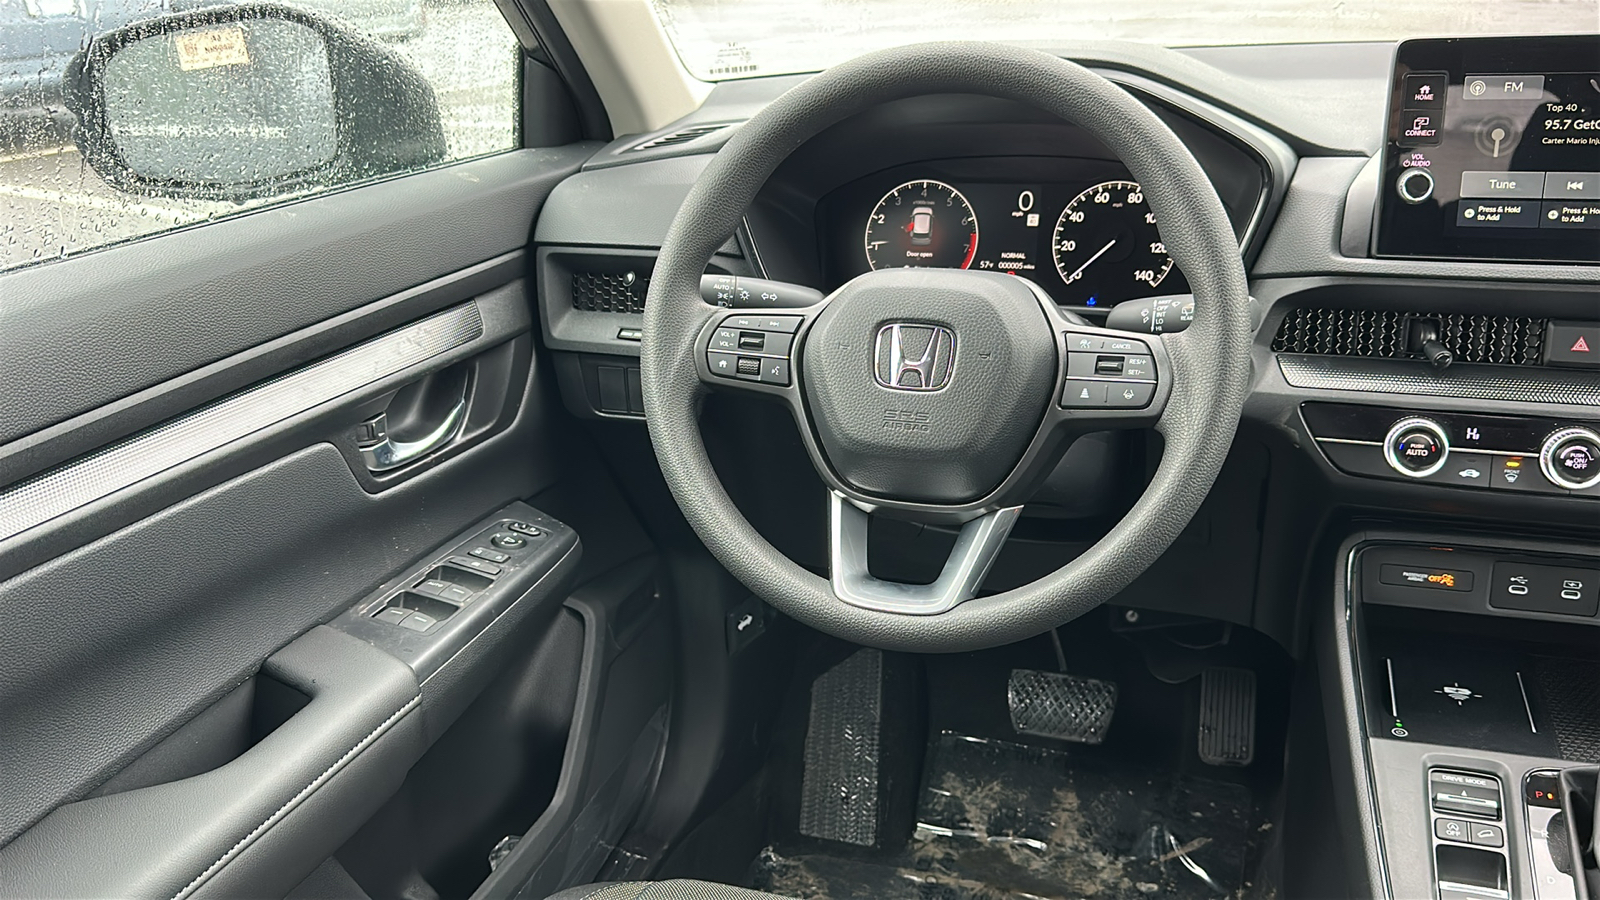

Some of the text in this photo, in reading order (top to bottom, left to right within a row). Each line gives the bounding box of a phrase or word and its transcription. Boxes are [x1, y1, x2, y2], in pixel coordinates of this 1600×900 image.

[1504, 81, 1524, 92] FM
[1546, 103, 1578, 113] Top 40
[1544, 119, 1572, 130] 95.7
[1489, 179, 1516, 190] Tune
[921, 189, 928, 198] 4
[1094, 192, 1110, 204] 60
[1127, 192, 1144, 204] 80
[895, 197, 902, 206] 3
[946, 198, 952, 206] 5
[1018, 190, 1034, 211] 0
[877, 214, 885, 224] 2
[962, 216, 968, 226] 6
[1069, 211, 1085, 222] 40
[963, 244, 969, 252] 7
[1060, 240, 1076, 251] 20
[1134, 270, 1154, 280] 140
[1428, 574, 1442, 582] OFF
[1442, 774, 1486, 786] DRIVE MODE
[1536, 790, 1544, 798] P
[1546, 876, 1556, 884] D
